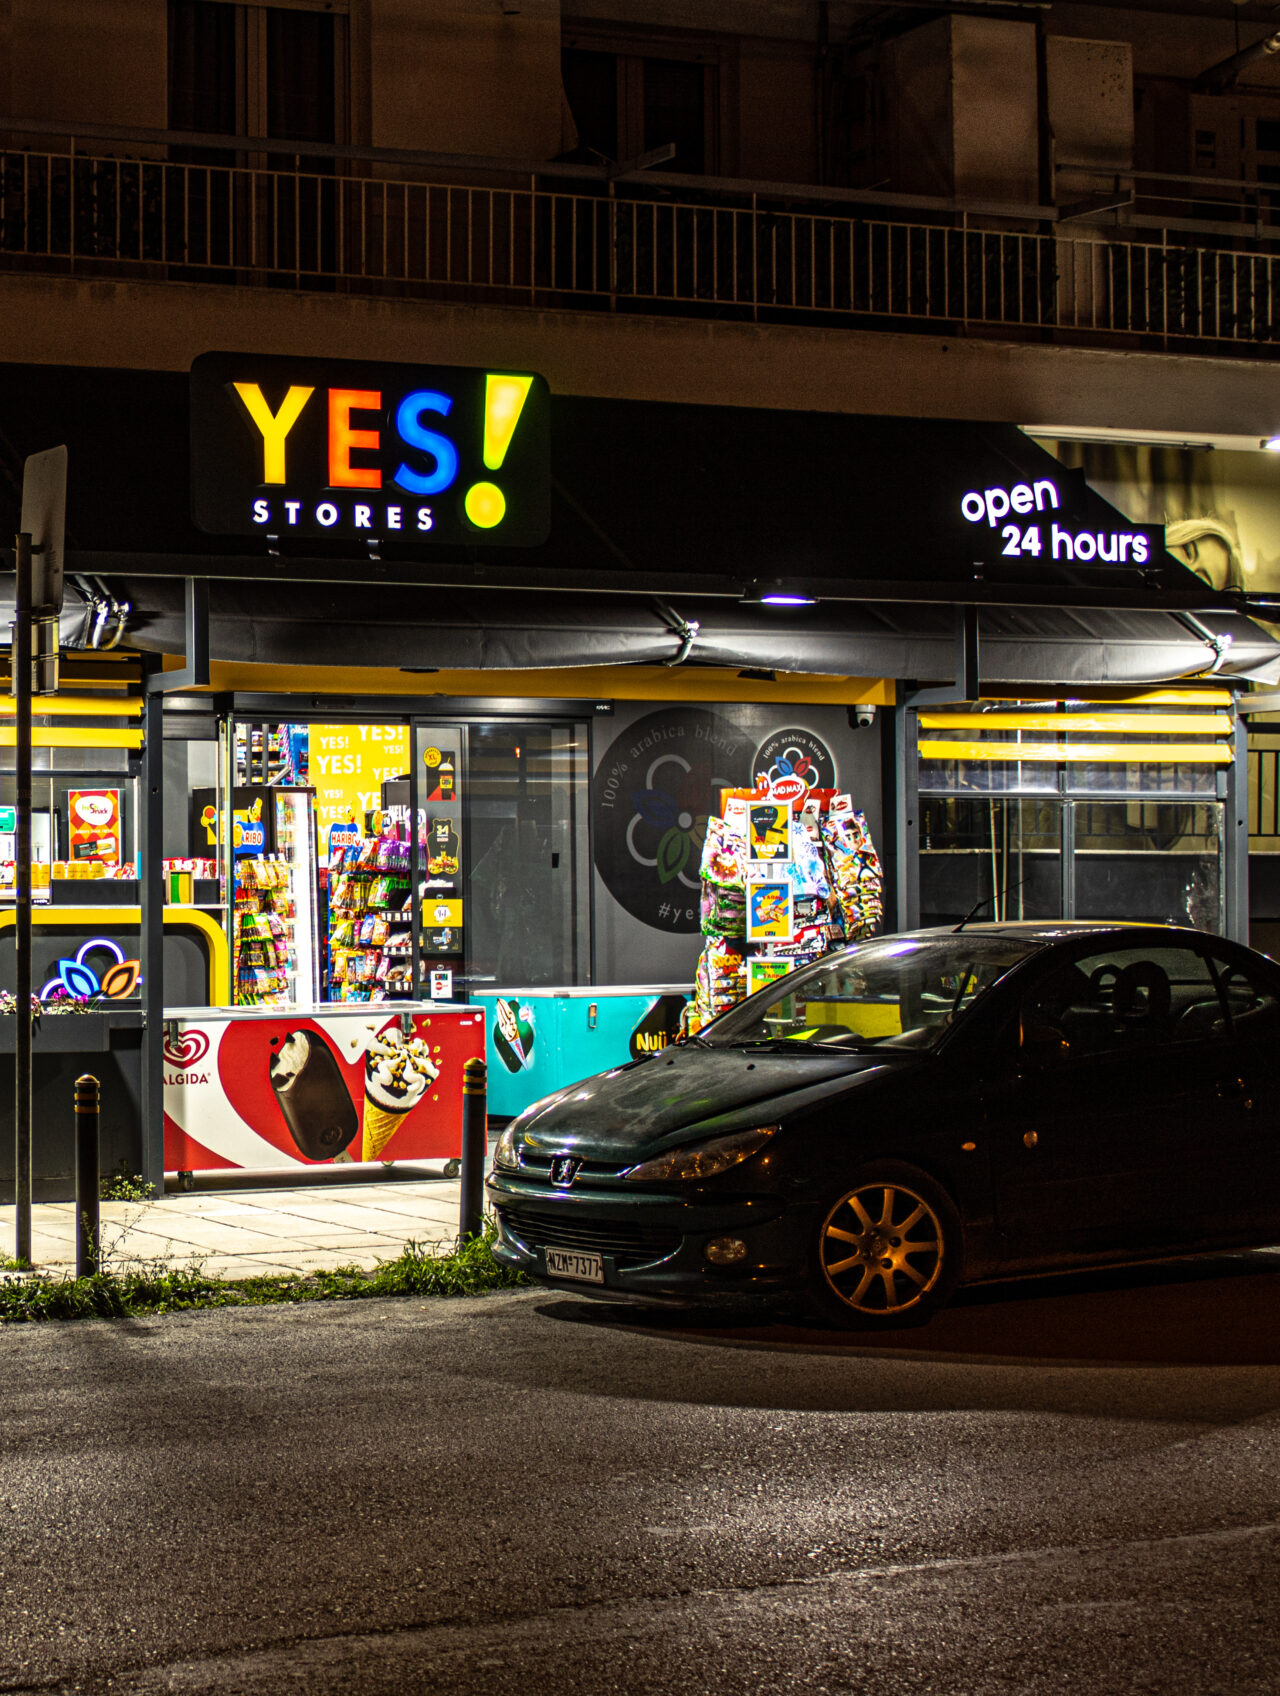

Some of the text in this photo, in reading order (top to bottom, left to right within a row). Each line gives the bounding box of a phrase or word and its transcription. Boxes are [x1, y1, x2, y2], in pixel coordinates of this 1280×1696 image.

[233, 374, 534, 528] YES!
[253, 499, 434, 531] STORES
[961, 480, 1060, 528] open
[1001, 523, 1148, 563] 24 hours
[320, 736, 349, 750] YES!
[357, 725, 403, 742] YES!
[383, 745, 404, 755] YES!
[763, 735, 825, 761] 100% arabica blend
[316, 754, 362, 775] YES!
[601, 724, 738, 809] 100% arabica blend
[323, 789, 343, 799] YES!
